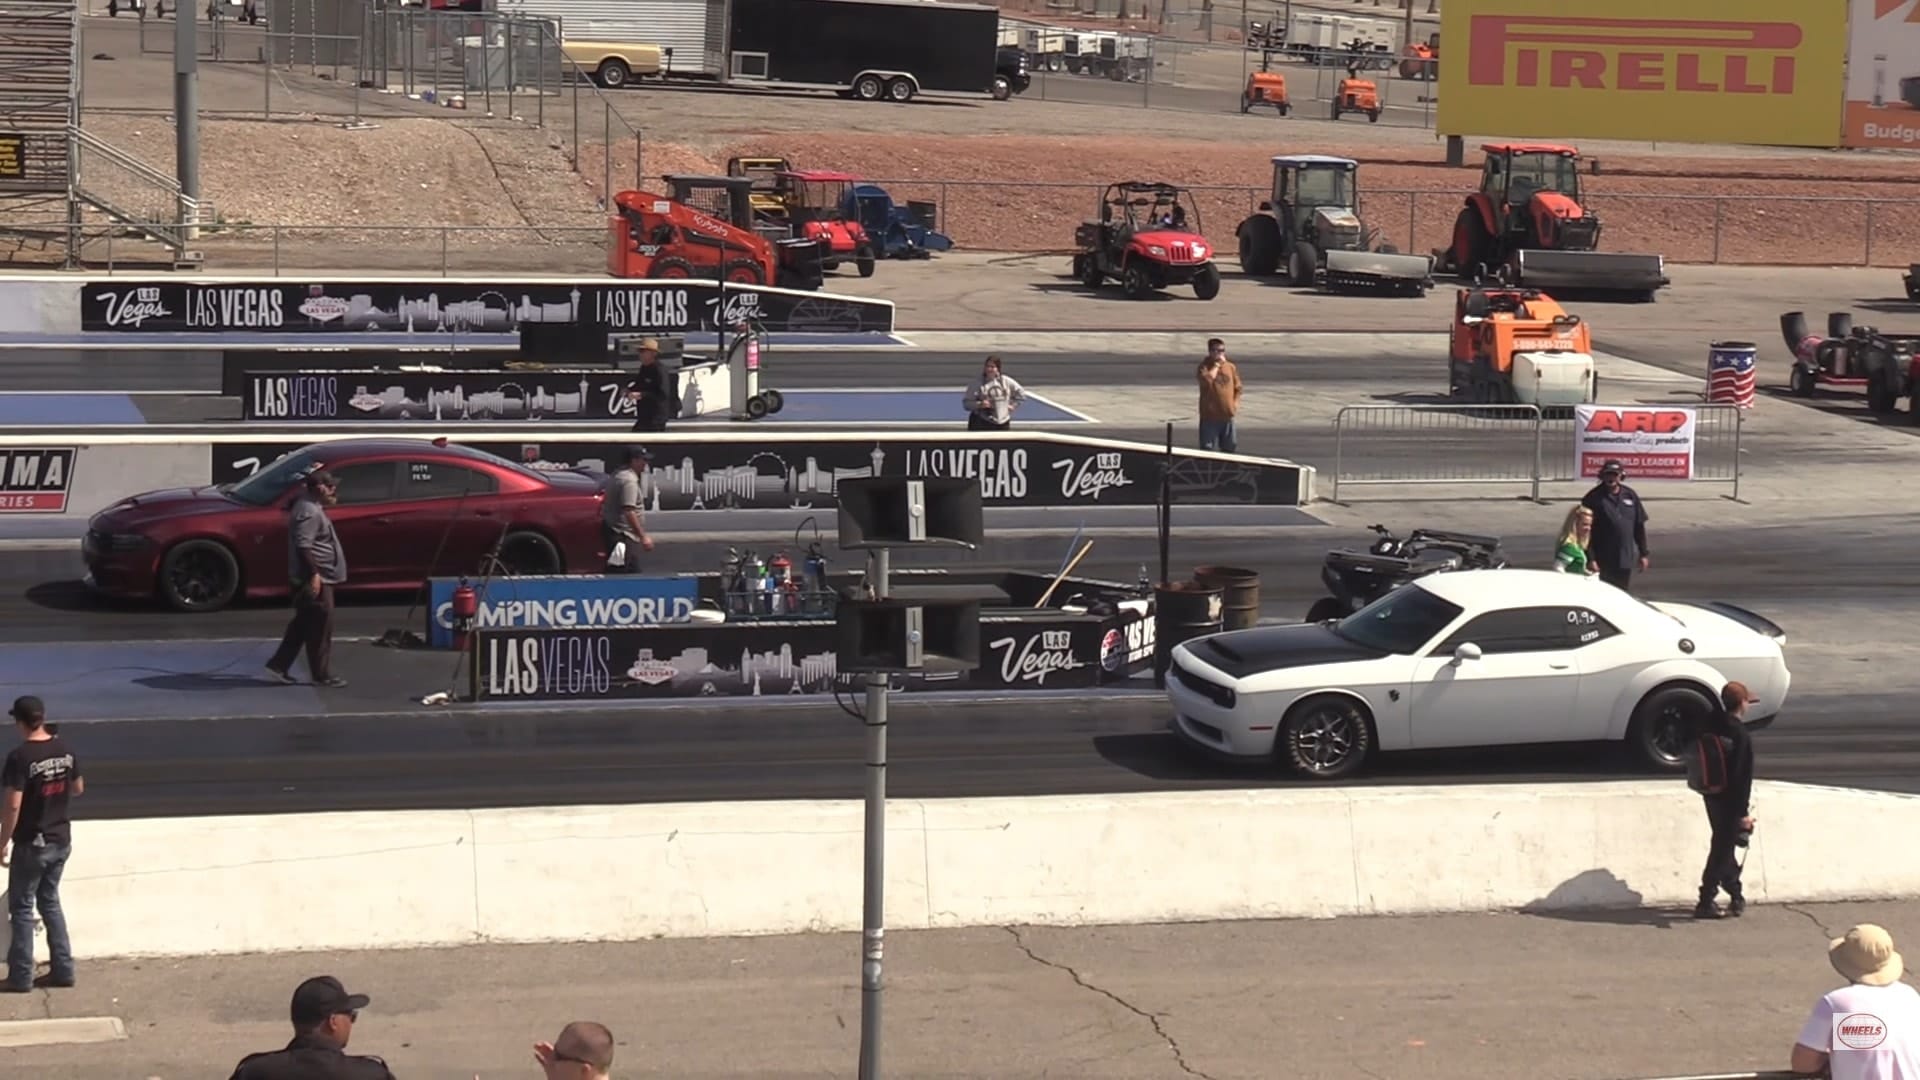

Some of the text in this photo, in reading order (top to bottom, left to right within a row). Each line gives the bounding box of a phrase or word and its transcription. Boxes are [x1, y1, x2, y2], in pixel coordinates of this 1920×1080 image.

[1468, 14, 1803, 95] PIRELLI
[96, 290, 172, 328] Vegas
[138, 288, 160, 301] LAS
[186, 289, 283, 327] LAS VEGAS
[628, 290, 688, 326] VEGAS
[254, 377, 337, 417] LAS VEGAS
[1585, 410, 1687, 433] ARP
[0, 456, 63, 486] MA
[1052, 456, 1134, 499] Vegas
[1097, 453, 1121, 469] LAS
[436, 597, 694, 629] CMPING WORLD
[1043, 631, 1070, 649] LAS
[490, 636, 610, 695] LAS VEGAS
[990, 633, 1084, 685] Vegas
